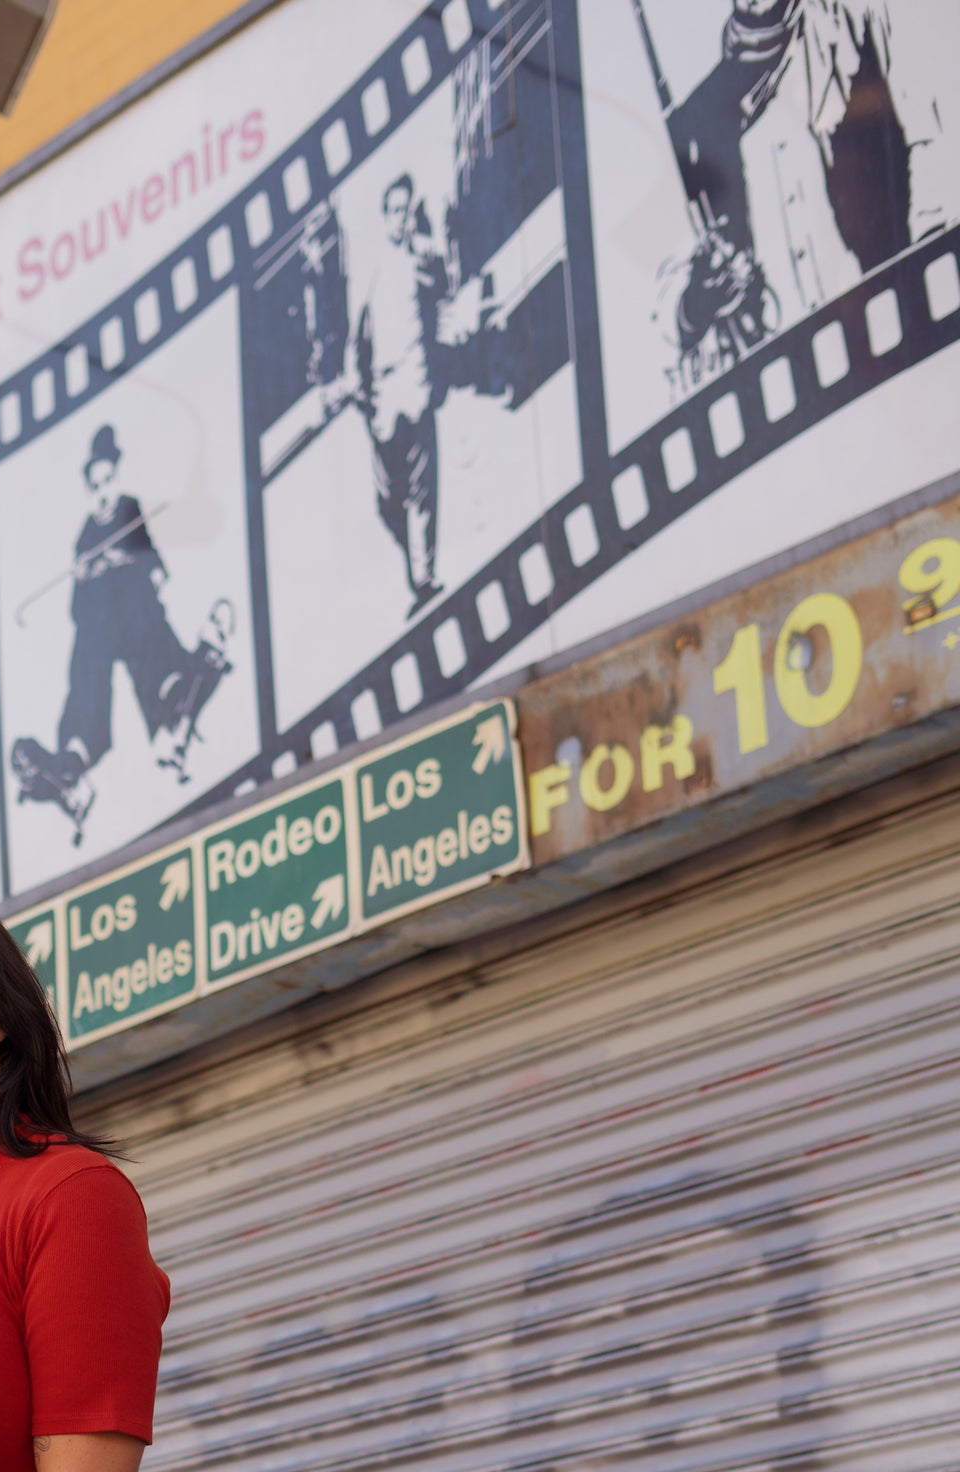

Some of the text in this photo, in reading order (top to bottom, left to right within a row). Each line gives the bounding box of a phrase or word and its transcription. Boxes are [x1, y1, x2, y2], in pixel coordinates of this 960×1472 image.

[17, 109, 266, 301] Souvenirs
[529, 715, 696, 836] FOR
[712, 592, 863, 755] 10
[360, 758, 442, 823] Los
[208, 805, 341, 891] Rodeo
[367, 805, 513, 897] Angeles
[70, 895, 137, 949] Los
[211, 902, 305, 971] Drive
[72, 940, 192, 1019] Angeles
